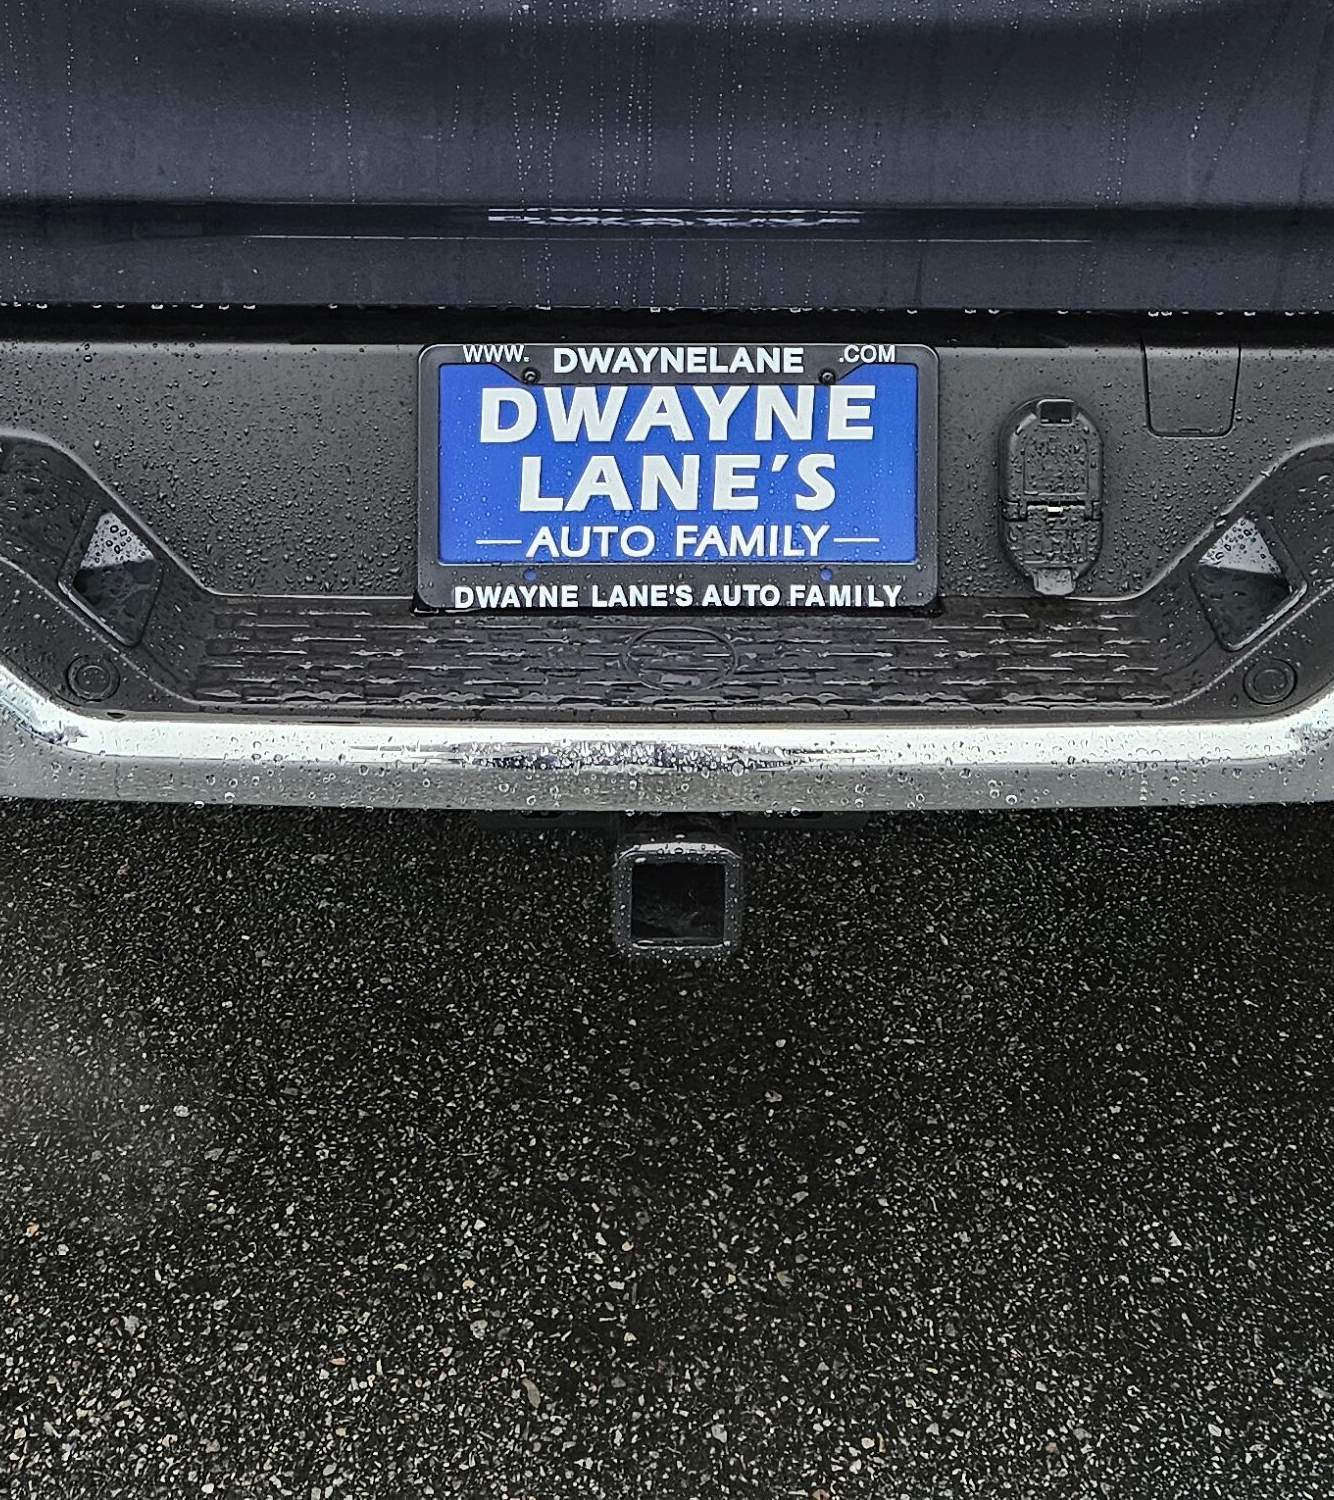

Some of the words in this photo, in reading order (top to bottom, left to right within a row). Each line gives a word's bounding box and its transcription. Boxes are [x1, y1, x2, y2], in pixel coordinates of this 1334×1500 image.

[553, 347, 804, 374] DWAYNELANE
[839, 345, 896, 363] .COM
[479, 385, 876, 443] DWAYNE
[519, 453, 836, 512] LANE'S
[525, 525, 656, 559] AUTO
[675, 524, 831, 558] FAMILY
[454, 584, 579, 609] DWAYNE
[591, 583, 694, 608] LANE'S
[701, 583, 781, 607] AUTO
[788, 583, 902, 608] FAMILY
